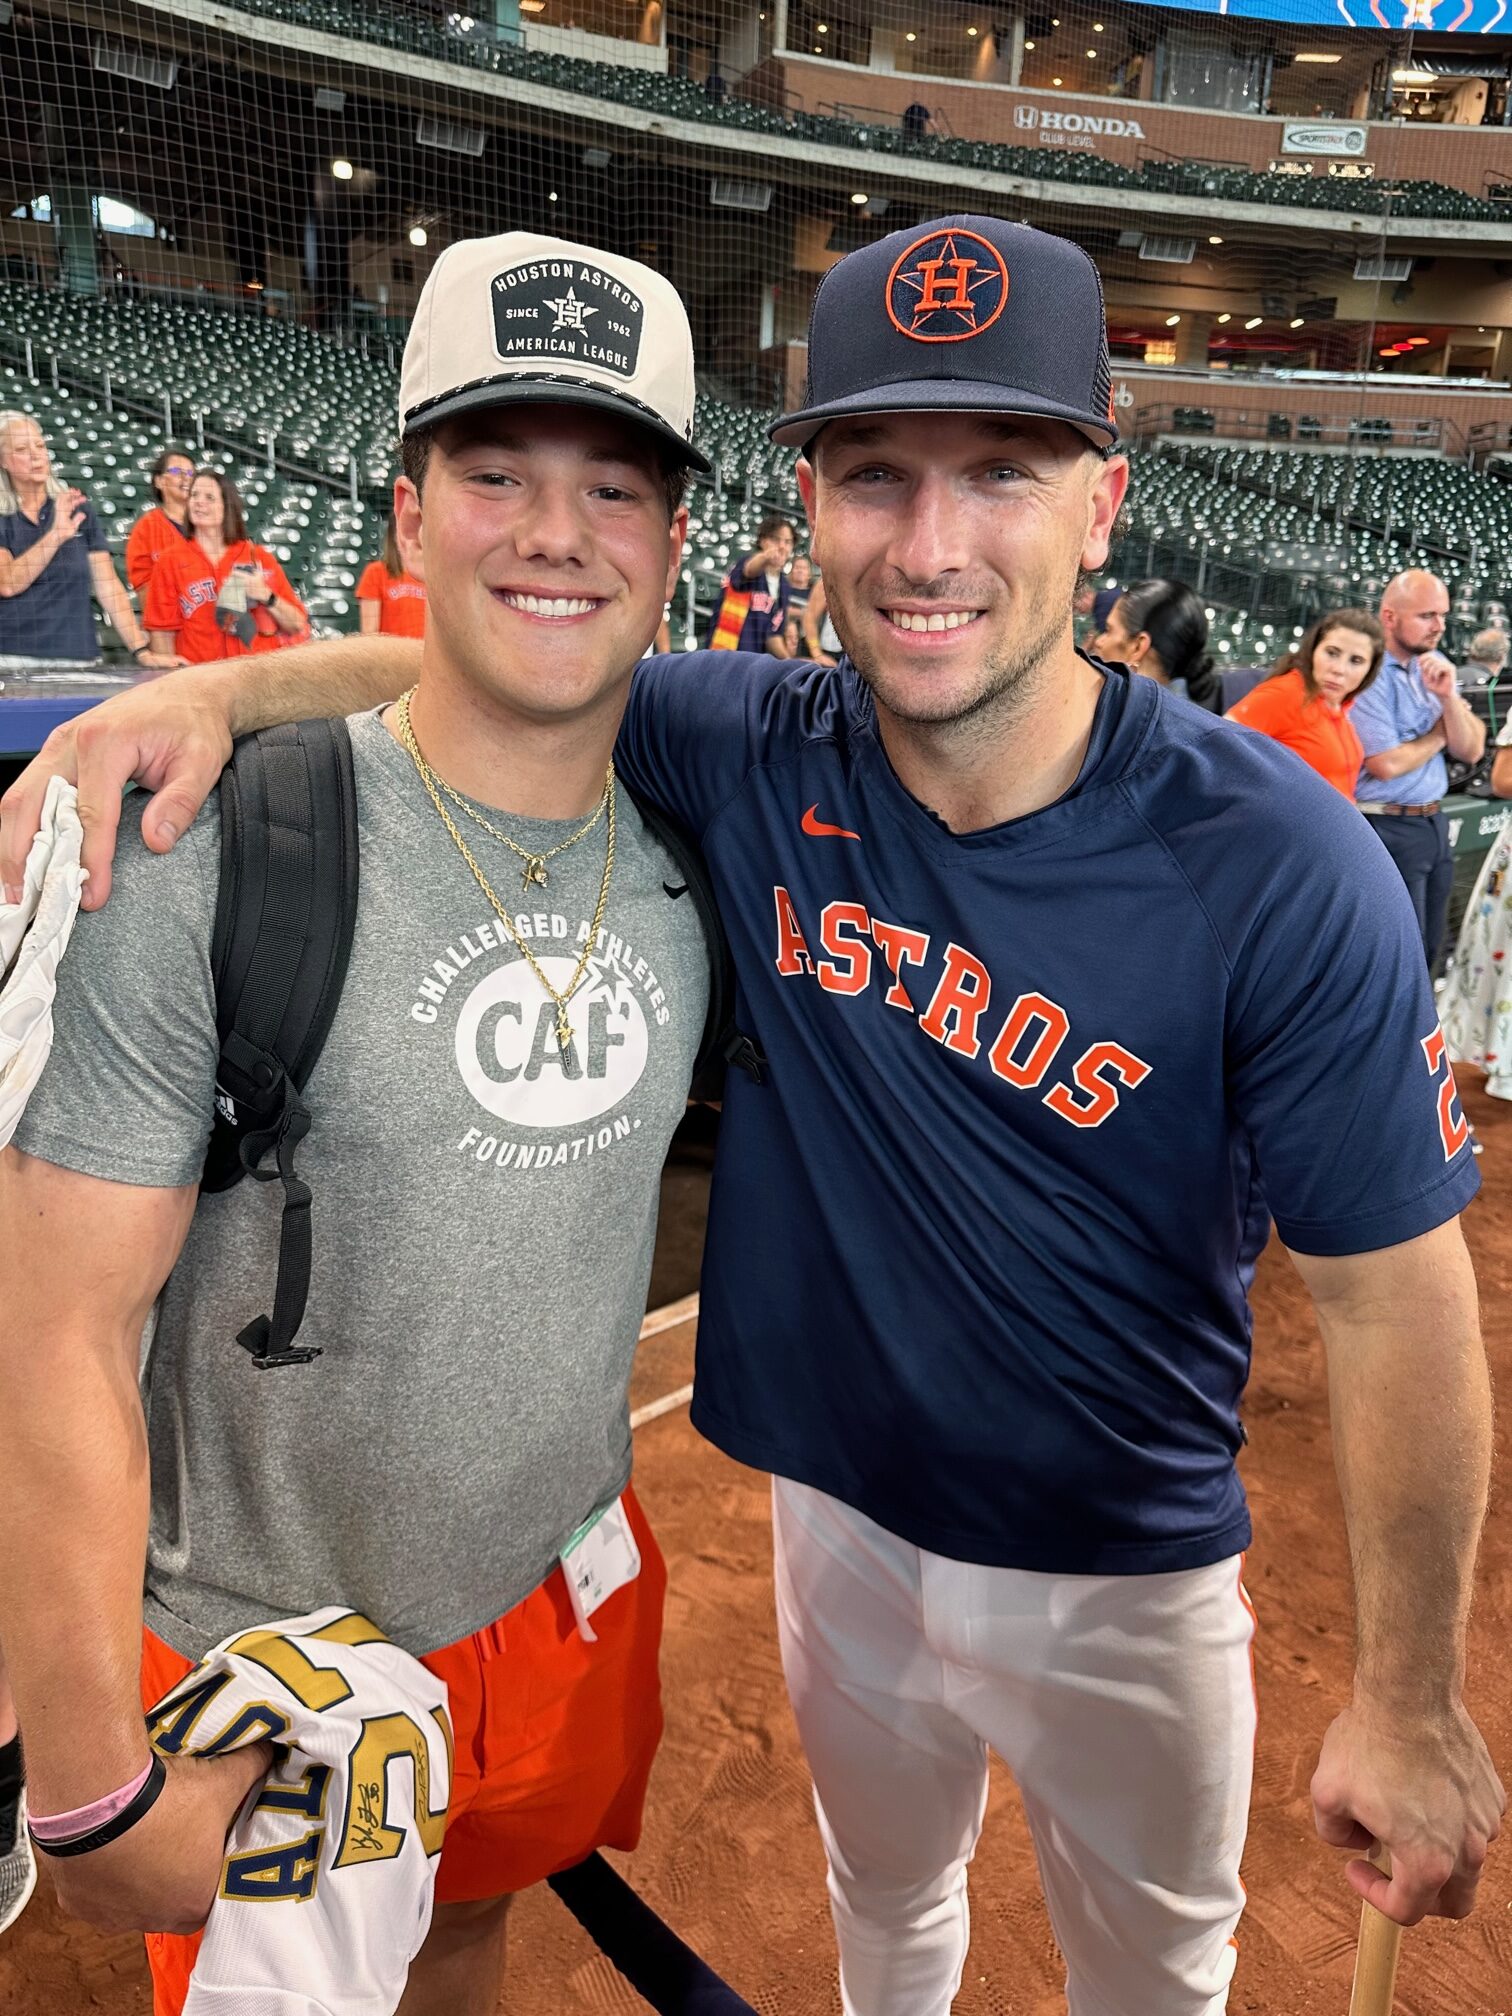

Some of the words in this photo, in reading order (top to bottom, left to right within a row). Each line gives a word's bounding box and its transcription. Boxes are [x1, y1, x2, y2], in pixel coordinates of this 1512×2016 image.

[1041, 111, 1146, 139] HONDA
[494, 263, 574, 292] HOUSTON
[580, 267, 641, 313] ASTROS
[505, 308, 539, 319] SINCE
[607, 320, 632, 338] 1962
[506, 337, 576, 354] AMERICAN
[583, 343, 628, 369] LEAGUE
[411, 913, 568, 1024] CHALLENGED
[576, 920, 671, 1026] ATHLETES
[773, 885, 1154, 1129] ASTROS
[475, 1000, 631, 1084] CAF
[1420, 1022, 1469, 1163] 2
